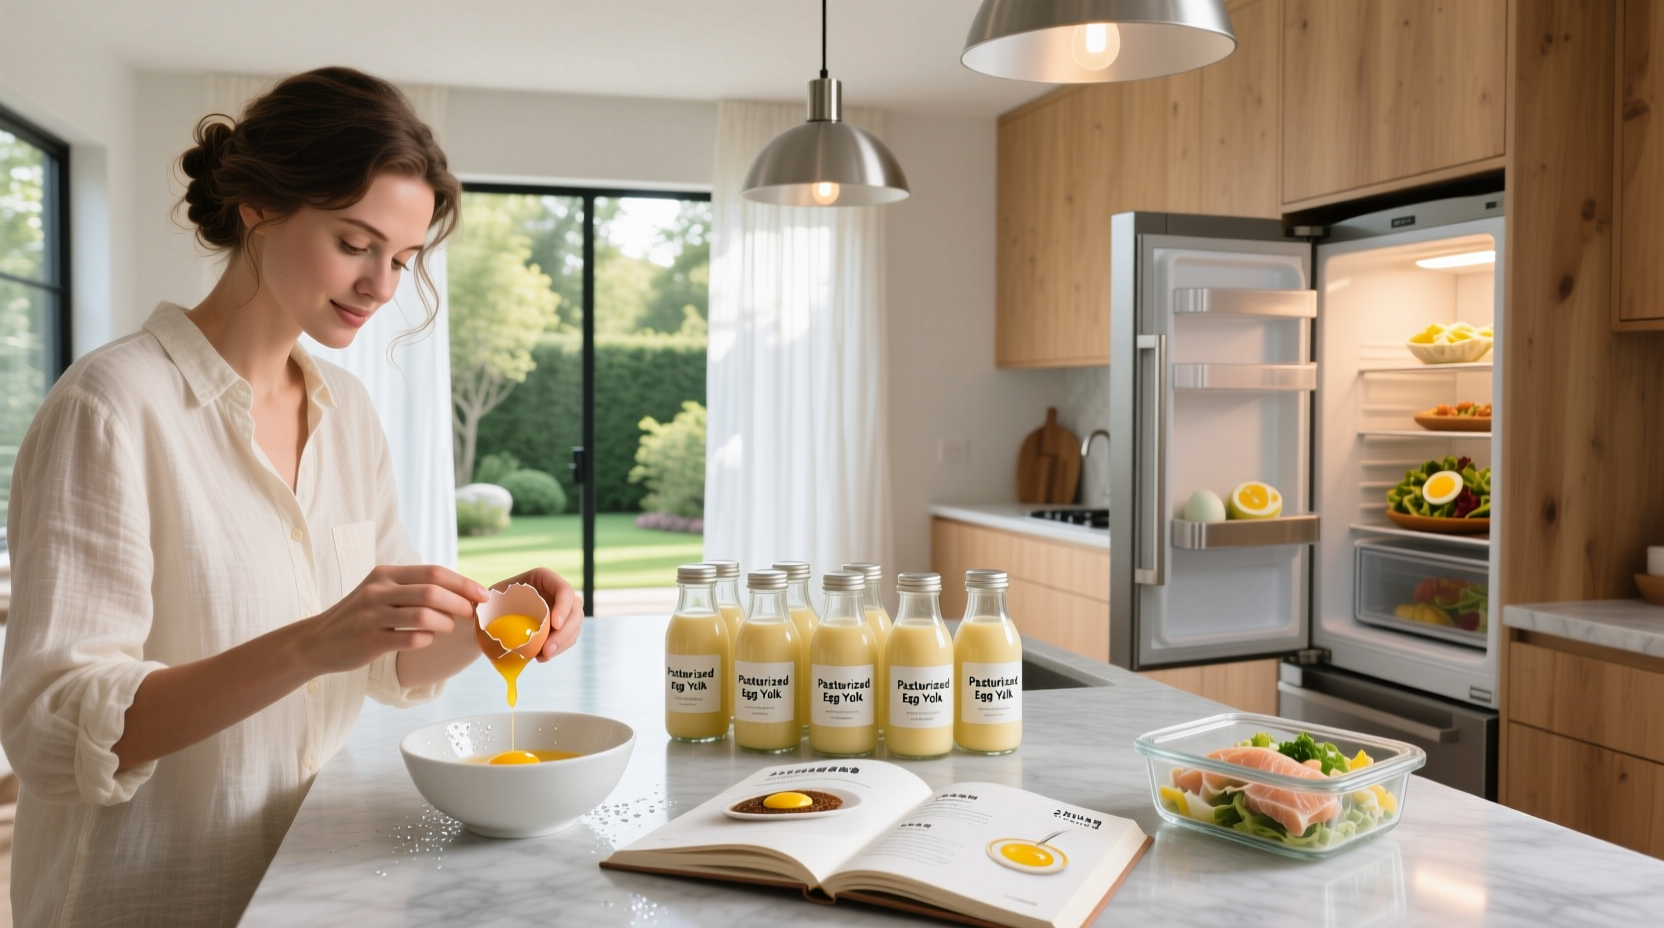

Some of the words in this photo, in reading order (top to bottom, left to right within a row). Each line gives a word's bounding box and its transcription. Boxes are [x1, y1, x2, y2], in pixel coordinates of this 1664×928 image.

[818, 677, 870, 690] Pasturized
[897, 677, 950, 690] Pasturized
[760, 688, 782, 699] Yolk
[974, 689, 993, 703] Egg
